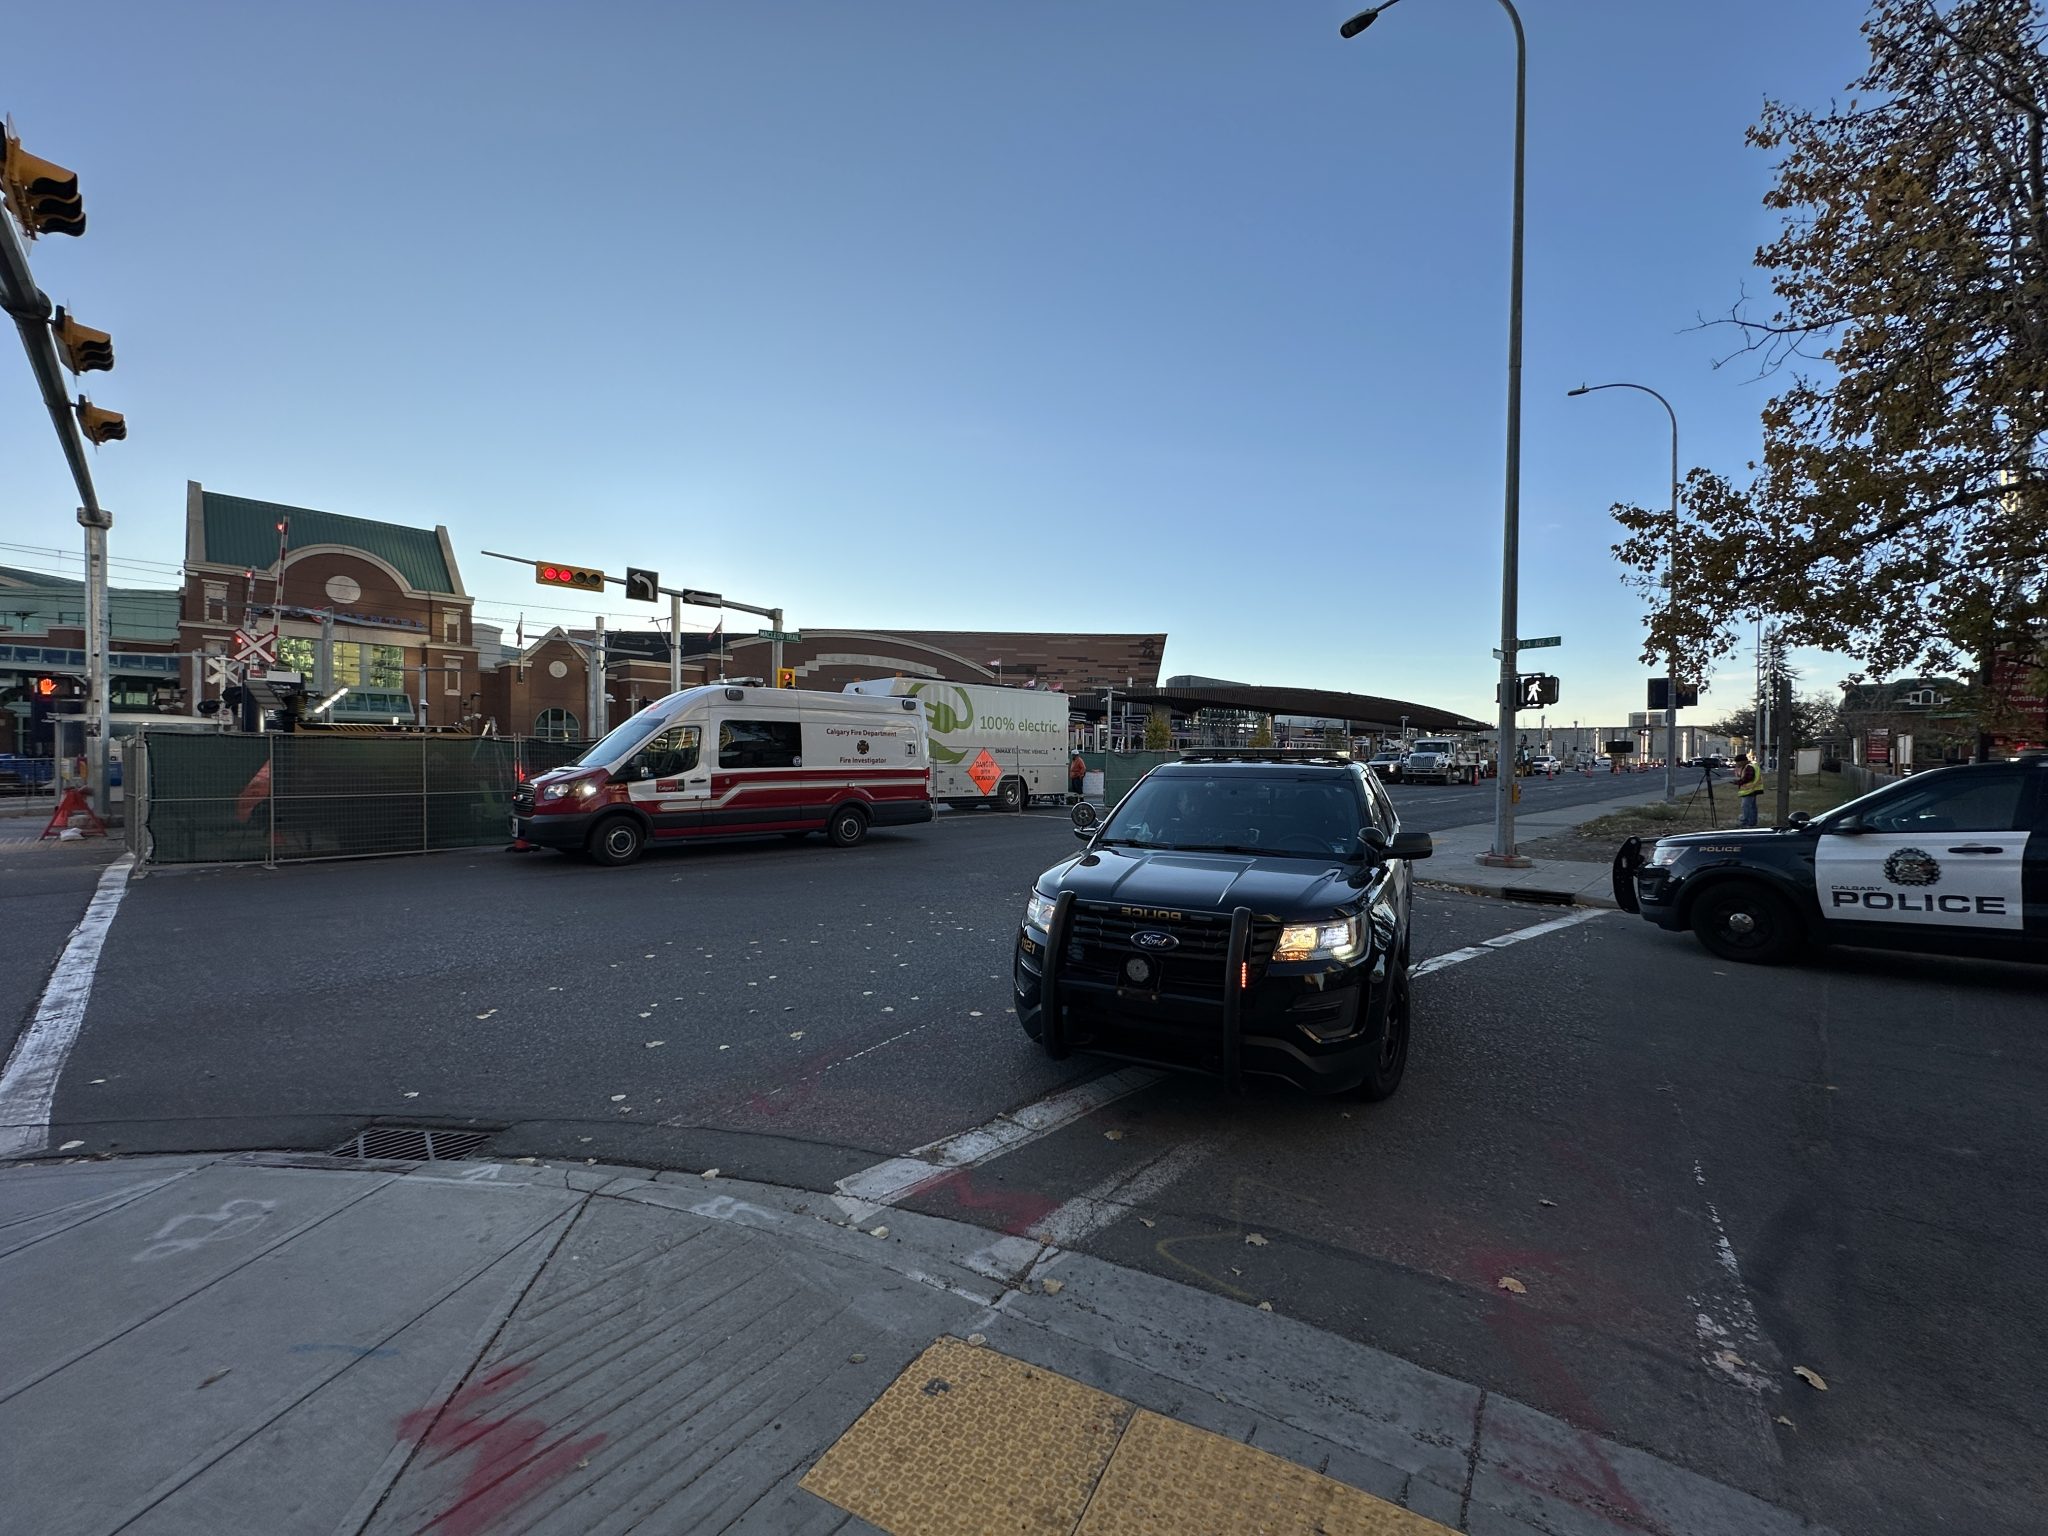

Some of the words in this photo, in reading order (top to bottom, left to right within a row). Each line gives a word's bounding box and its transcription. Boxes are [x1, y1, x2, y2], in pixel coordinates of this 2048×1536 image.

[760, 630, 784, 639] MACLEOD
[980, 716, 1015, 731] 100%
[1018, 718, 1060, 733] electric.
[826, 728, 850, 737] Calgary
[862, 729, 897, 738] Department
[852, 756, 887, 765] Investigator
[1832, 891, 2007, 916] POLICE
[1021, 936, 1036, 955] 1121
[1140, 933, 1168, 947] Ford
